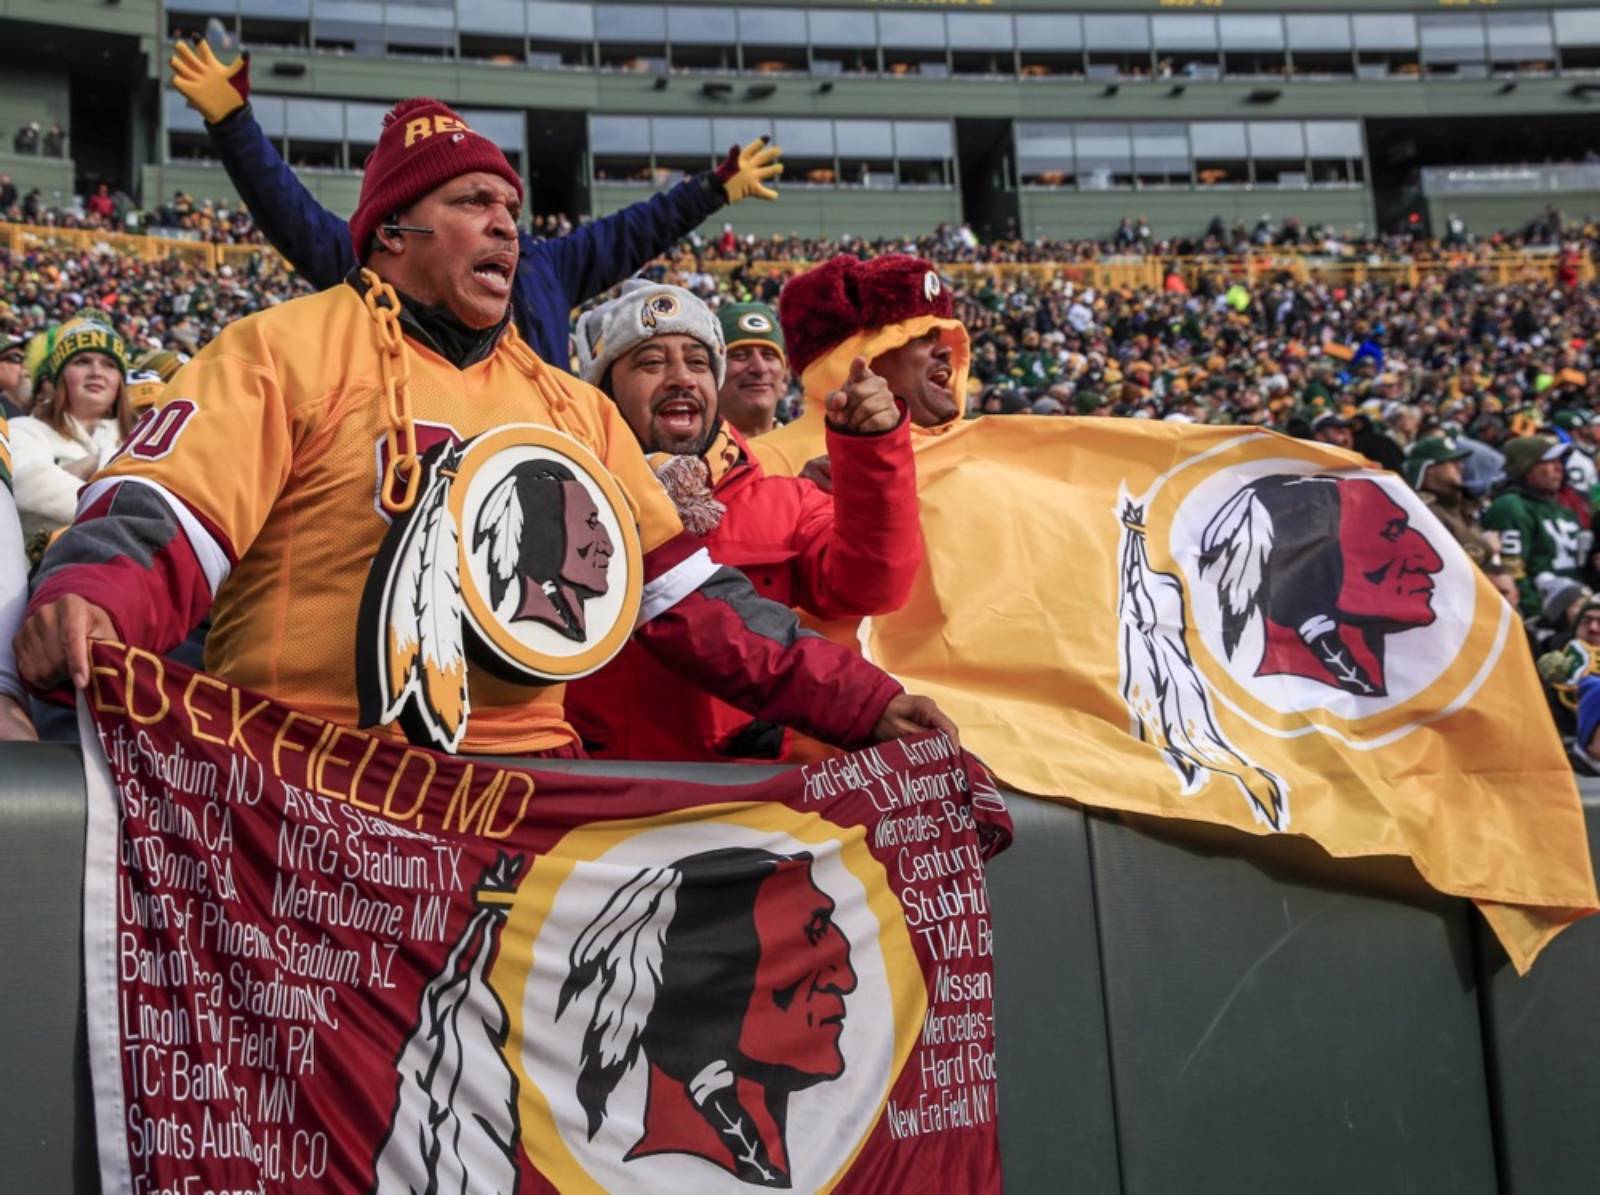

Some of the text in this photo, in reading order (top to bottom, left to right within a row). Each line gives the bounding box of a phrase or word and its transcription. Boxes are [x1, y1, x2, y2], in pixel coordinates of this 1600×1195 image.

[183, 673, 270, 762] EX
[272, 711, 436, 830] FIELD,
[441, 763, 535, 840] MD
[225, 752, 264, 806] NJ
[203, 801, 233, 853] CA
[280, 779, 341, 828] AT&T
[277, 820, 464, 894] NRG Stadium, TX
[272, 871, 452, 943] MetroDome, MN
[121, 931, 168, 988] Bank
[368, 941, 399, 989] AZ
[286, 1026, 315, 1075] PA
[921, 1044, 965, 1091] Hard
[172, 1048, 230, 1102] Bank
[257, 1073, 298, 1125] MN
[887, 1099, 920, 1140] New
[920, 1093, 942, 1133] Era
[292, 1130, 329, 1180] CO
